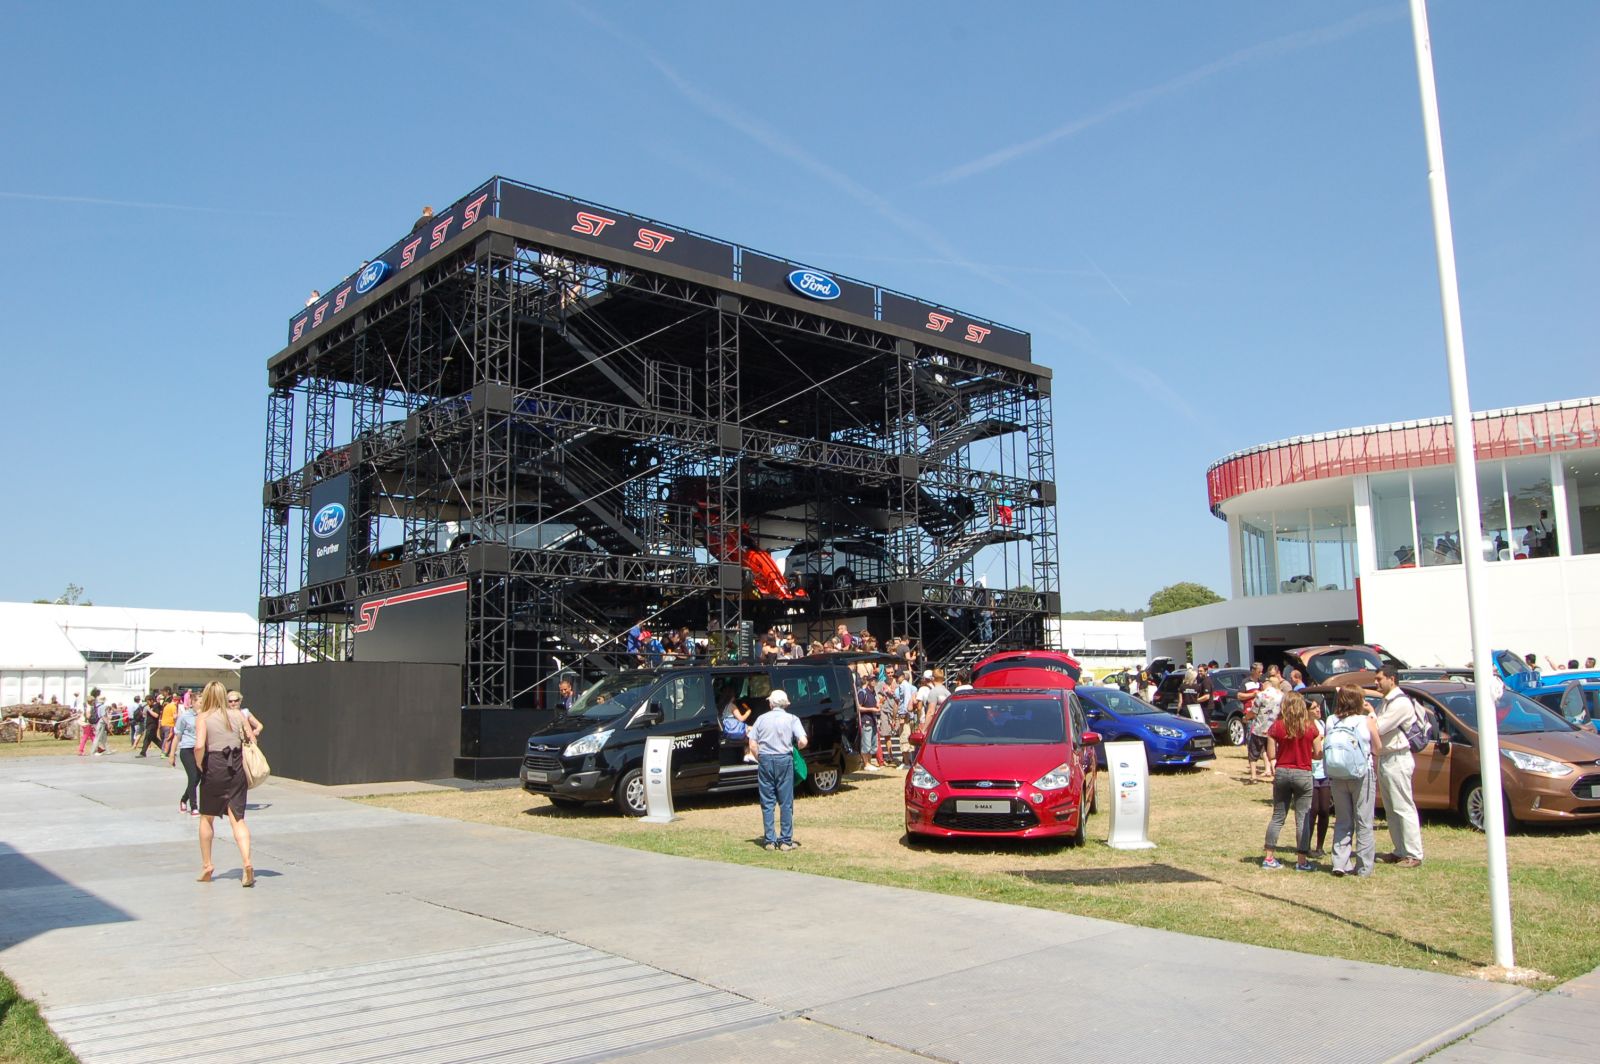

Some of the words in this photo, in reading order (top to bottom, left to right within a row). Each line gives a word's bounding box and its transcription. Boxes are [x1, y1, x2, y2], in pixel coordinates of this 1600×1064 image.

[462, 194, 488, 230] ST
[571, 211, 616, 237] ST
[430, 216, 453, 250] ST
[633, 228, 675, 253] ST
[400, 237, 422, 269] ST
[333, 286, 351, 313] ST
[312, 302, 329, 329] ST
[926, 312, 954, 333] ST
[292, 317, 308, 343] ST
[965, 324, 991, 344] ST
[316, 547, 323, 558] Go
[323, 543, 340, 556] Further
[356, 599, 386, 633] ST
